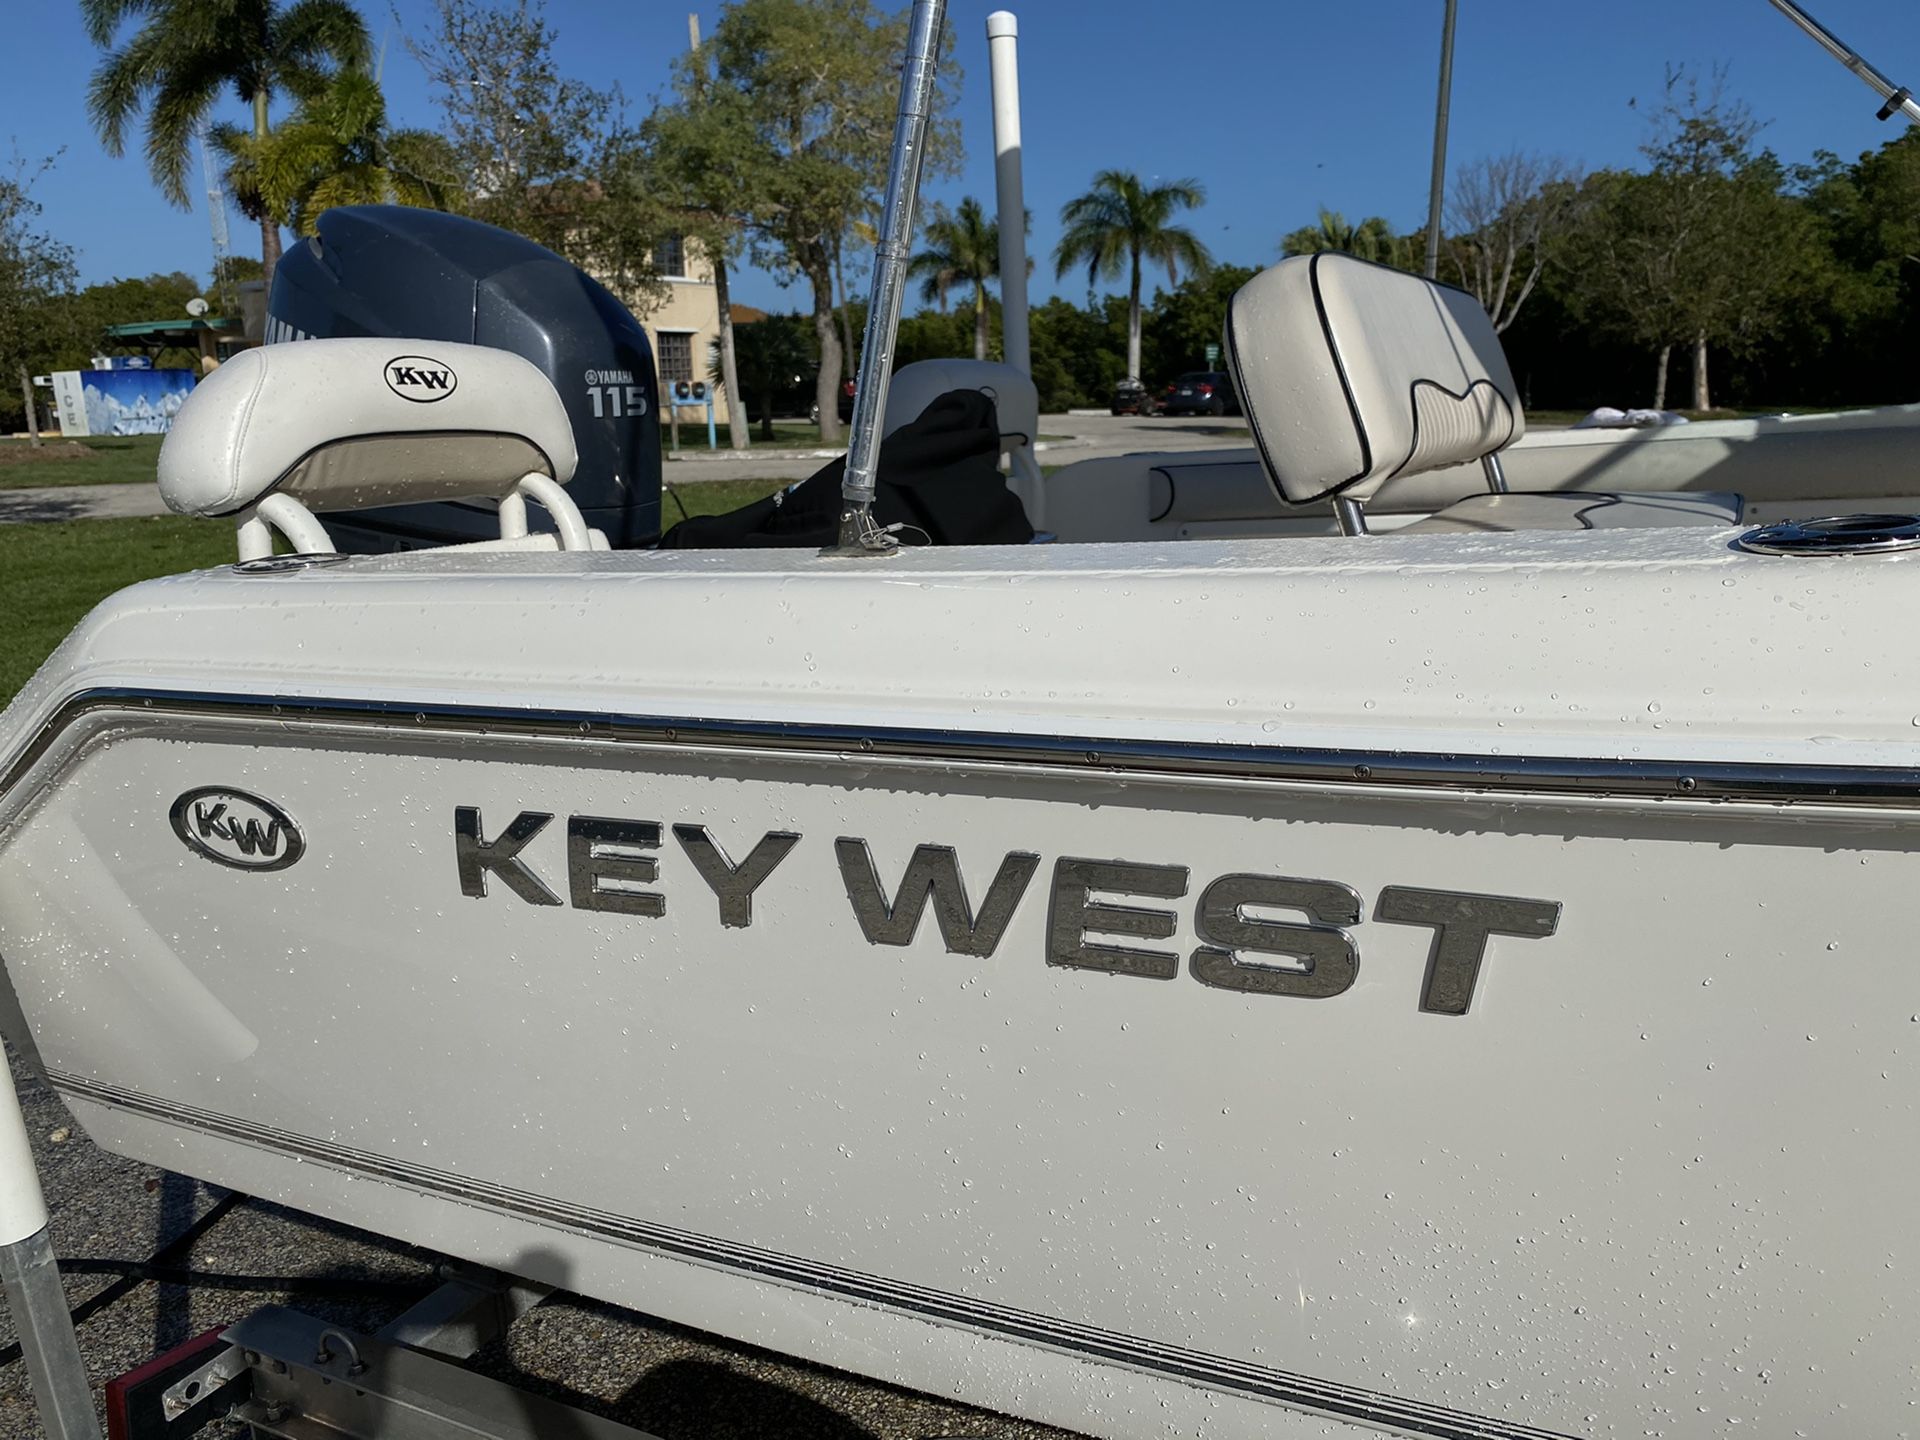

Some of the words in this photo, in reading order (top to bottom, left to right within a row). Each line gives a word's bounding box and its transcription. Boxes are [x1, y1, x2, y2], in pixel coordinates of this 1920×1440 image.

[390, 366, 449, 390] KW
[597, 370, 634, 385] YAMAHA
[63, 376, 77, 426] ICE
[586, 386, 647, 418] 115
[195, 801, 280, 857] KW
[455, 805, 803, 929] KEY
[834, 836, 1563, 1016] WEST
